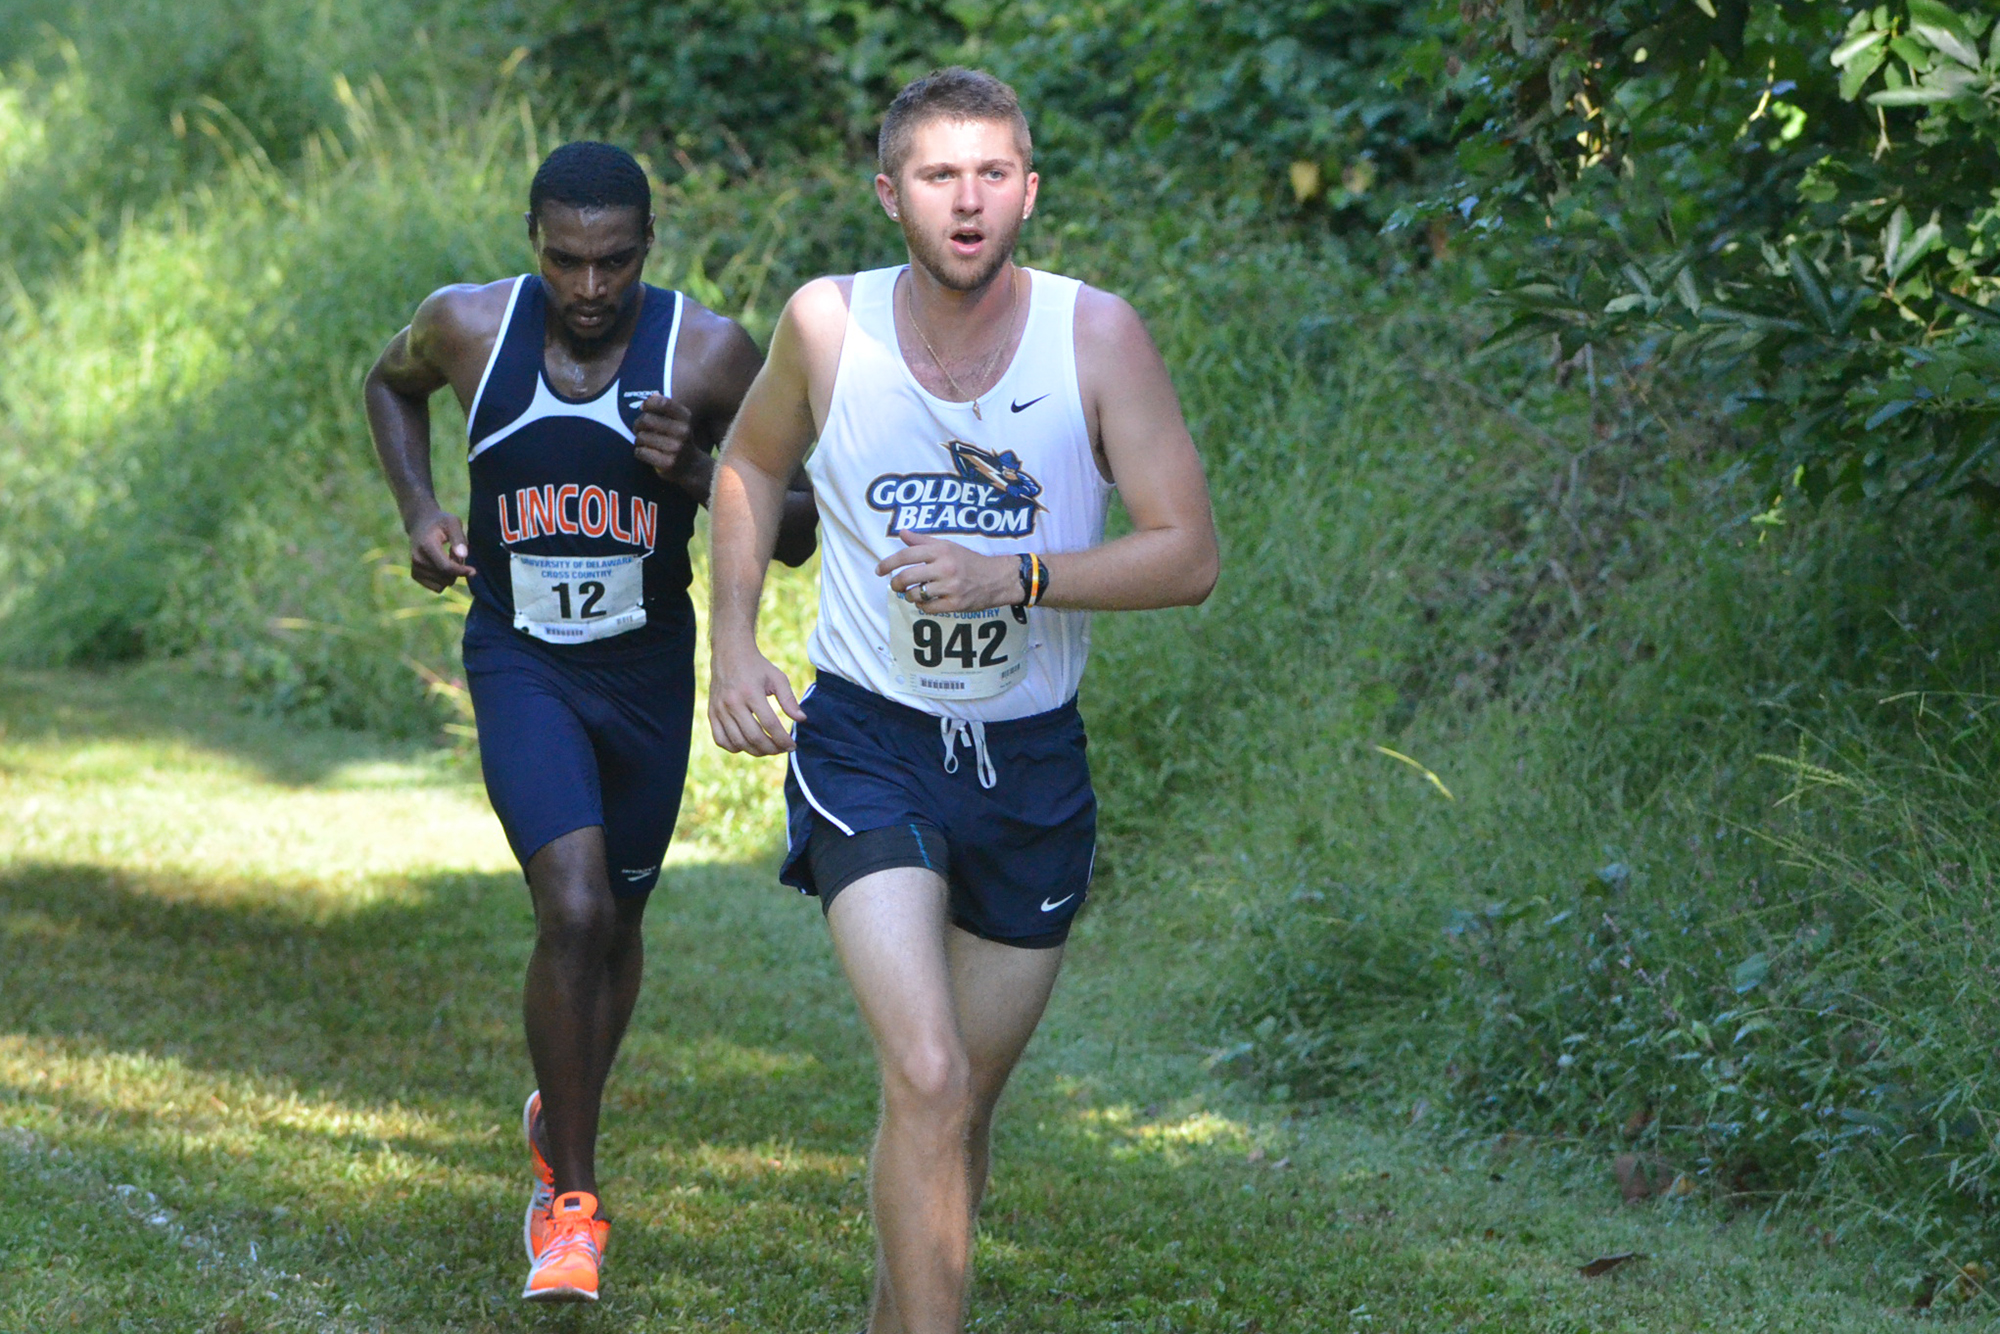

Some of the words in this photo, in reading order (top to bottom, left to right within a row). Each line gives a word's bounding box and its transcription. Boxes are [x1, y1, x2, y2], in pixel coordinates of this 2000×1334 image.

[498, 484, 658, 549] LINCOLN
[894, 504, 1030, 532] BEACOM
[520, 556, 570, 569] UNIVERSITY
[573, 560, 583, 569] OF
[586, 556, 633, 568] DELAWARE
[541, 570, 570, 579] CROSS
[572, 569, 612, 579] COUNTRY
[551, 580, 607, 619] 12
[953, 607, 1000, 619] COUNTRY
[912, 618, 1009, 669] 942
